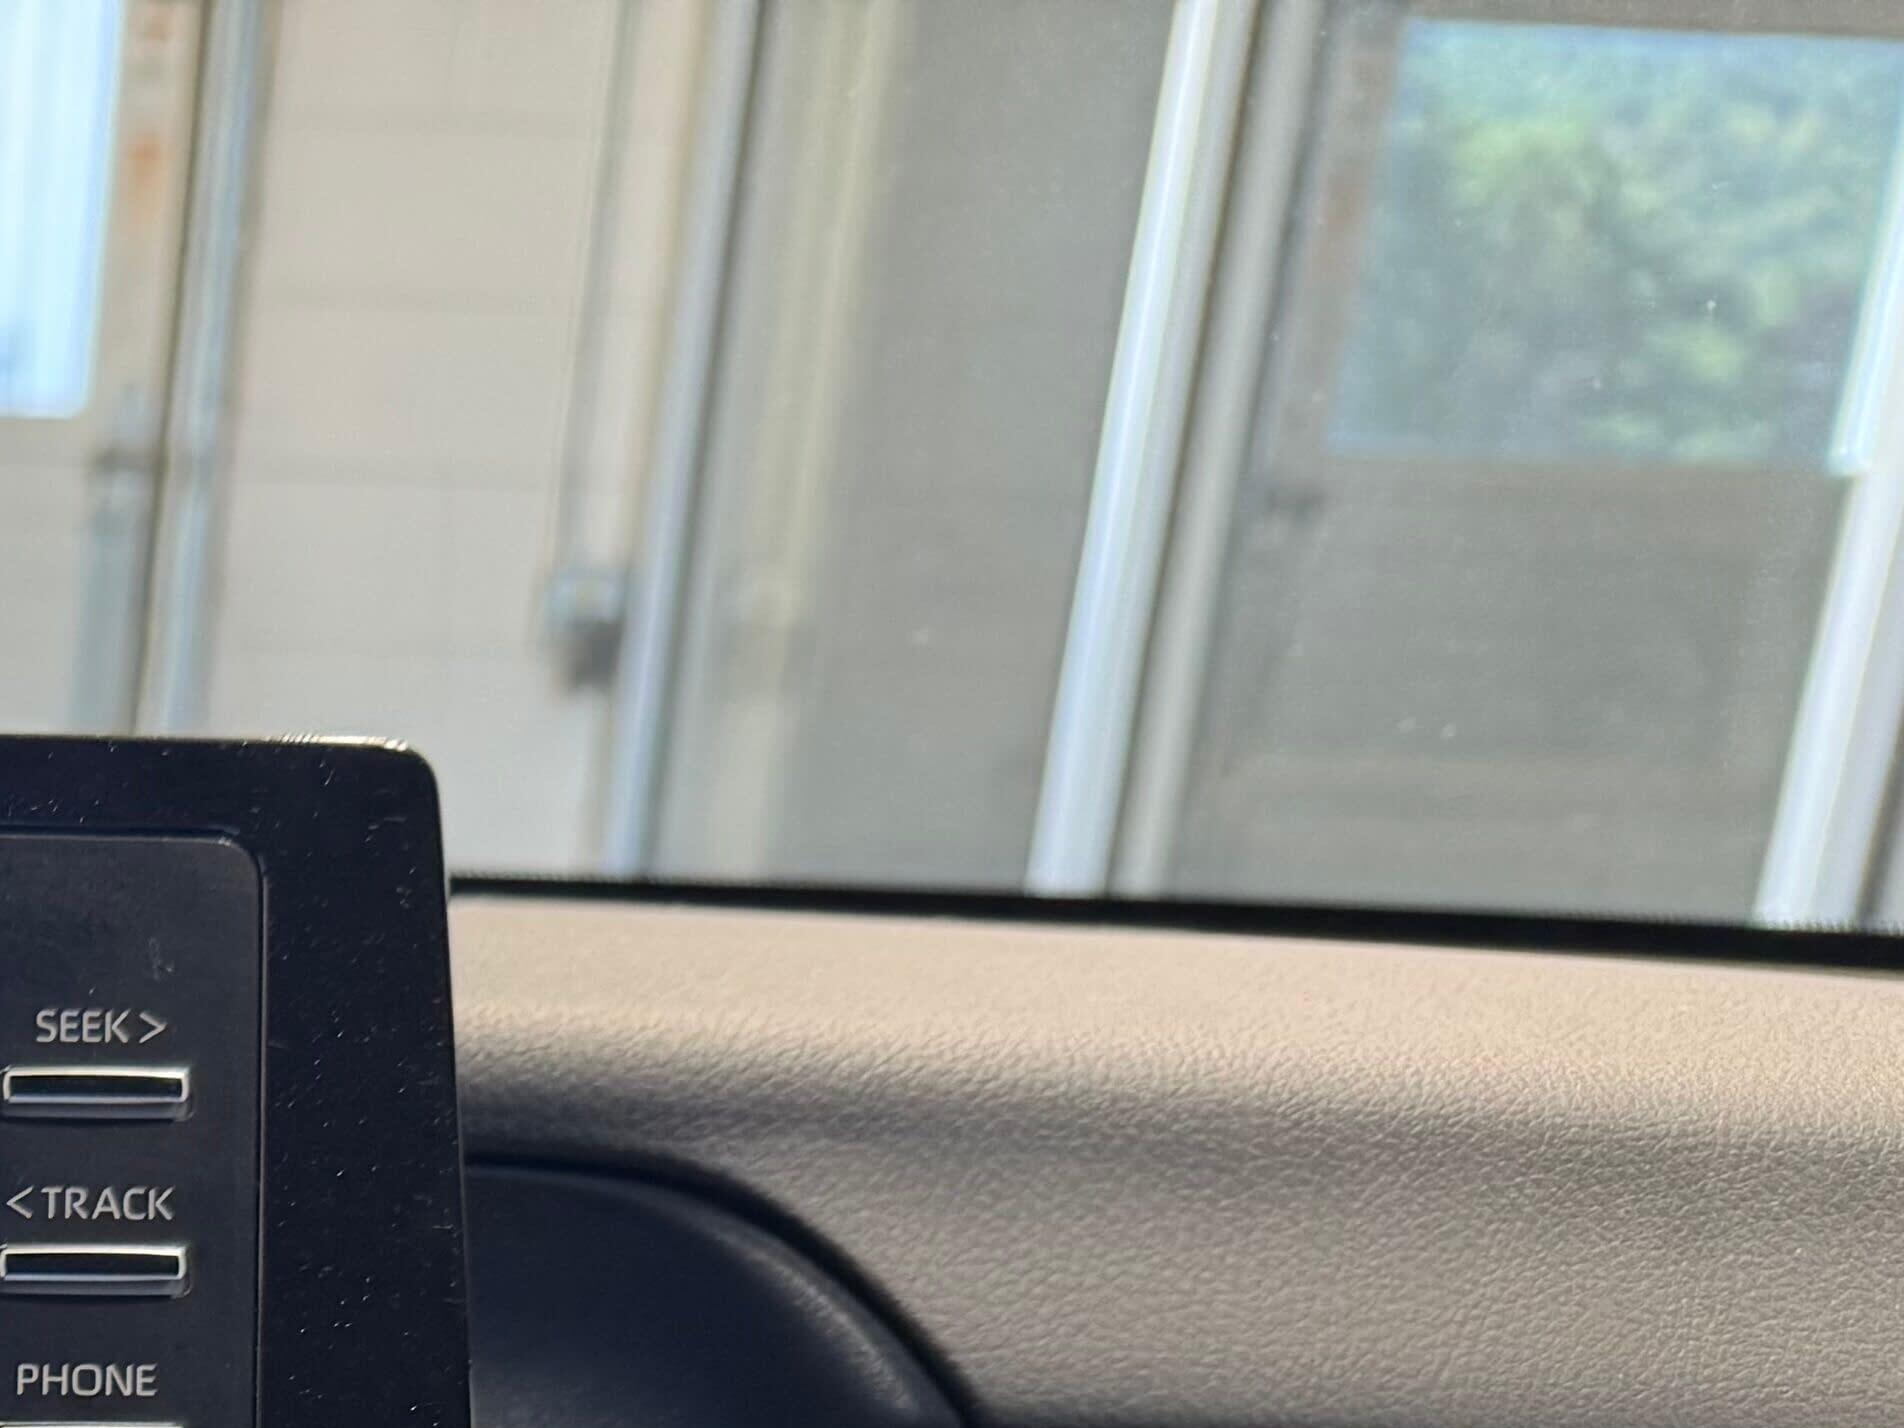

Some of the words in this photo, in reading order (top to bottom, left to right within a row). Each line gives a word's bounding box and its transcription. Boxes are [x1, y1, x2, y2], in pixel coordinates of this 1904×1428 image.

[35, 1007, 130, 1044] SEEK
[40, 1185, 175, 1221] TRACK
[15, 1363, 158, 1397] PHONE
